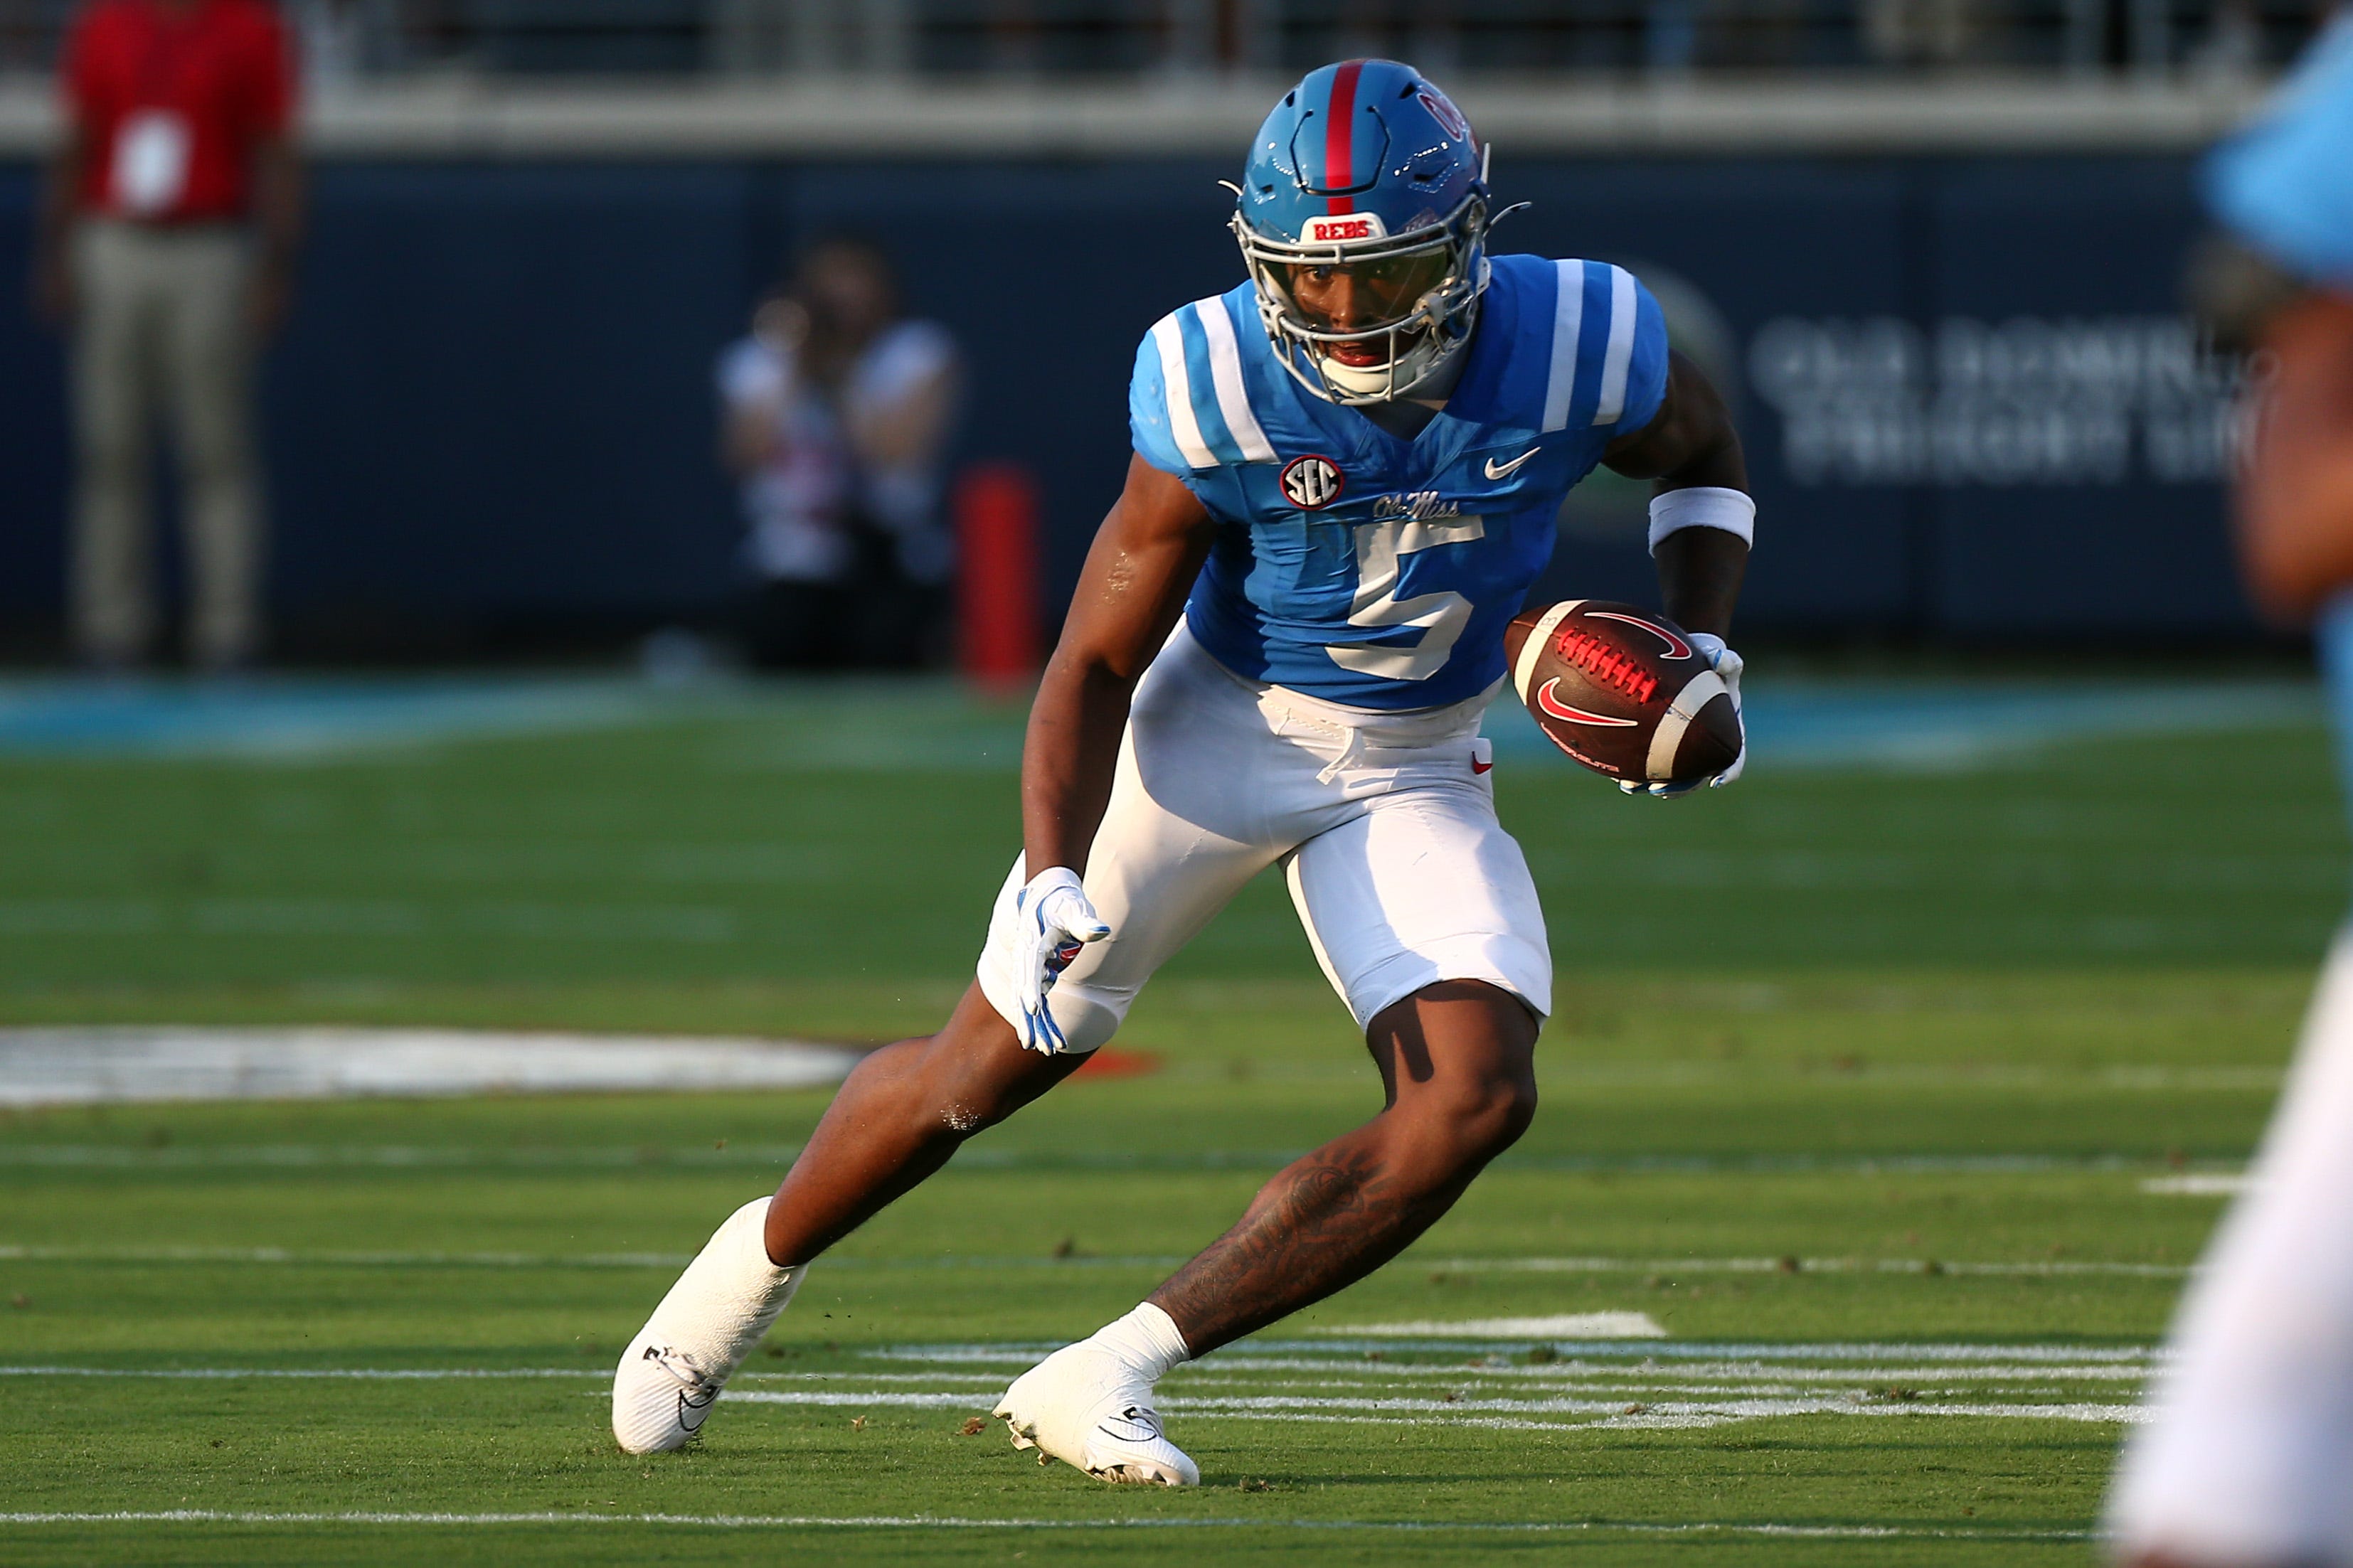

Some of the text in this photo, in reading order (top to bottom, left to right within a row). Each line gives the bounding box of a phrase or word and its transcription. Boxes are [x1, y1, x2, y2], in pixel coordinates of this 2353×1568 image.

[1313, 220, 1369, 240] REBS
[1285, 459, 1338, 506] SEC
[1373, 491, 1461, 520] Ole Miss
[1324, 514, 1485, 681] 5
